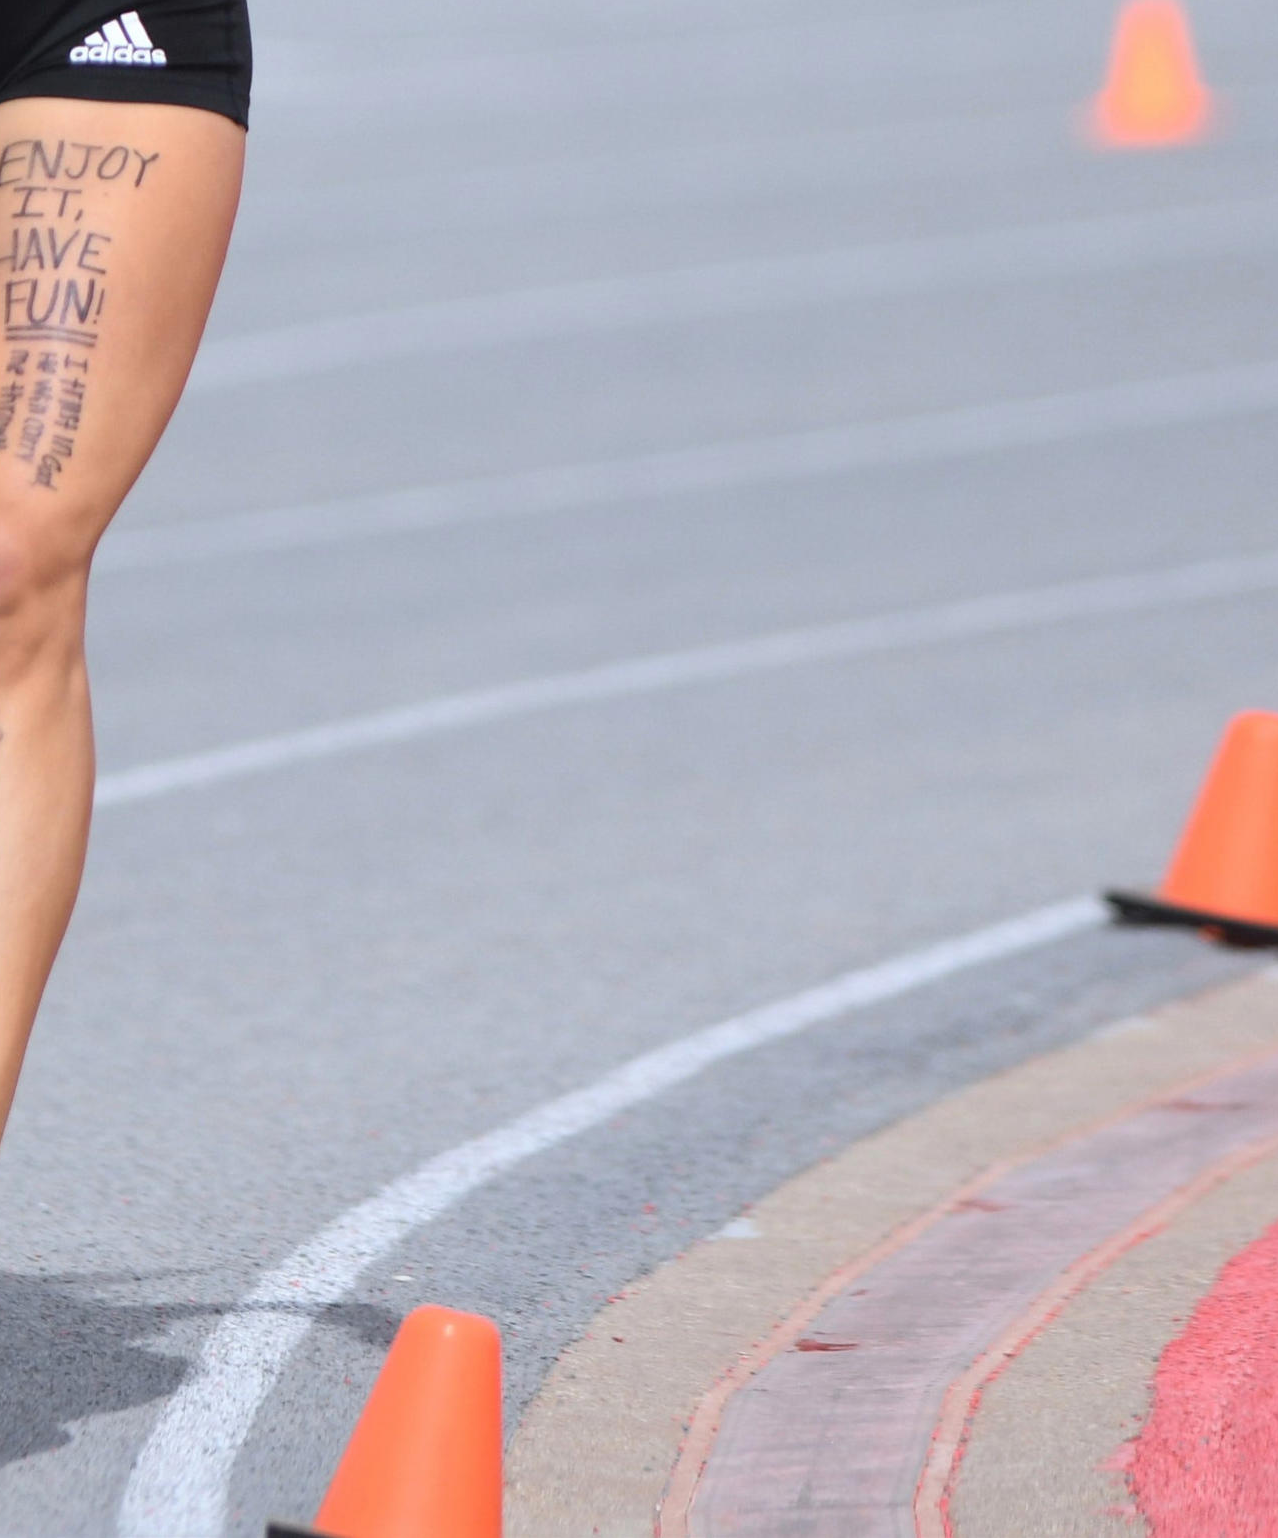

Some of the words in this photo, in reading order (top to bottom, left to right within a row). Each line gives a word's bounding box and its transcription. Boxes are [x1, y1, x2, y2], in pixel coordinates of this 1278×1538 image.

[70, 41, 167, 66] adidas
[11, 187, 84, 222] IT,
[4, 277, 105, 328] FUN!
[64, 353, 88, 374] I
